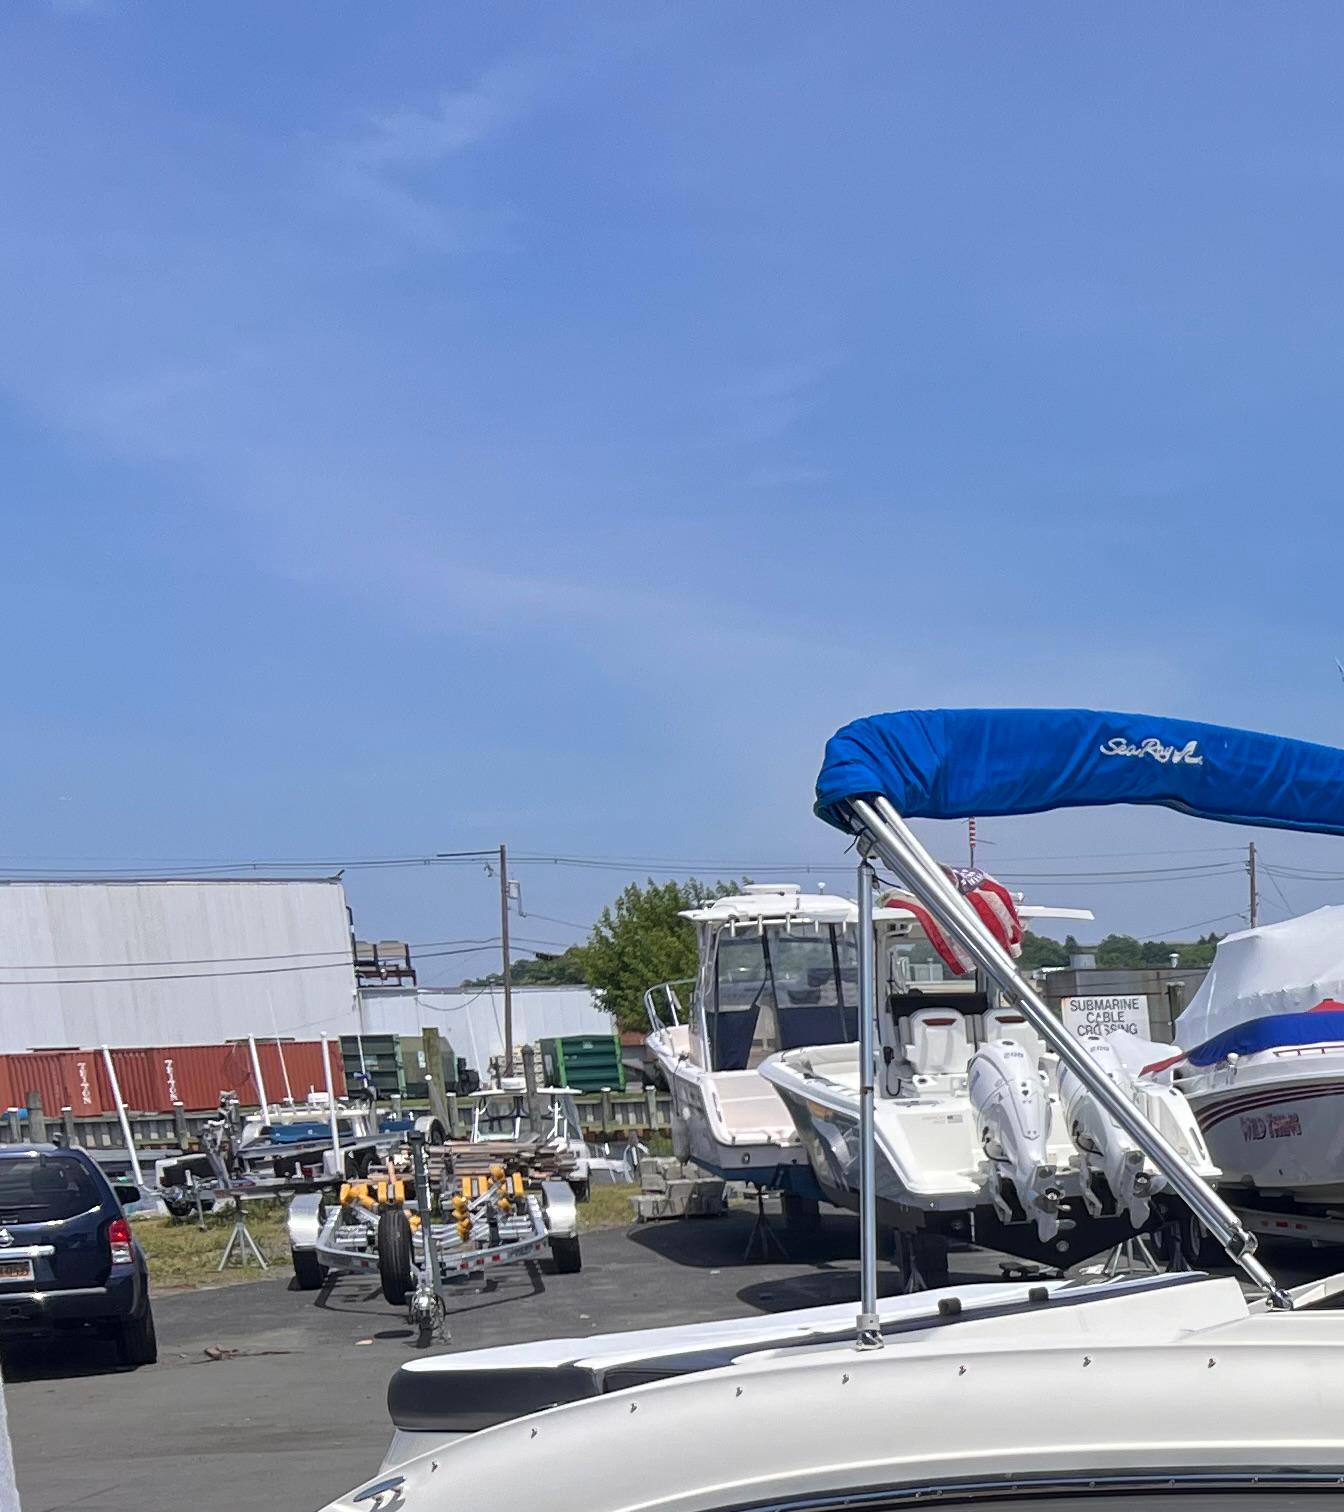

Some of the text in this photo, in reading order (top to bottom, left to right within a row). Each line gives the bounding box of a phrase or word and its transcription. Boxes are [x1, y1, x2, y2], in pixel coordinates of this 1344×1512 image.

[1100, 738, 1173, 763] Sea Ray
[1070, 998, 1140, 1012] SUBMARINE
[1086, 1011, 1125, 1024] CABLE
